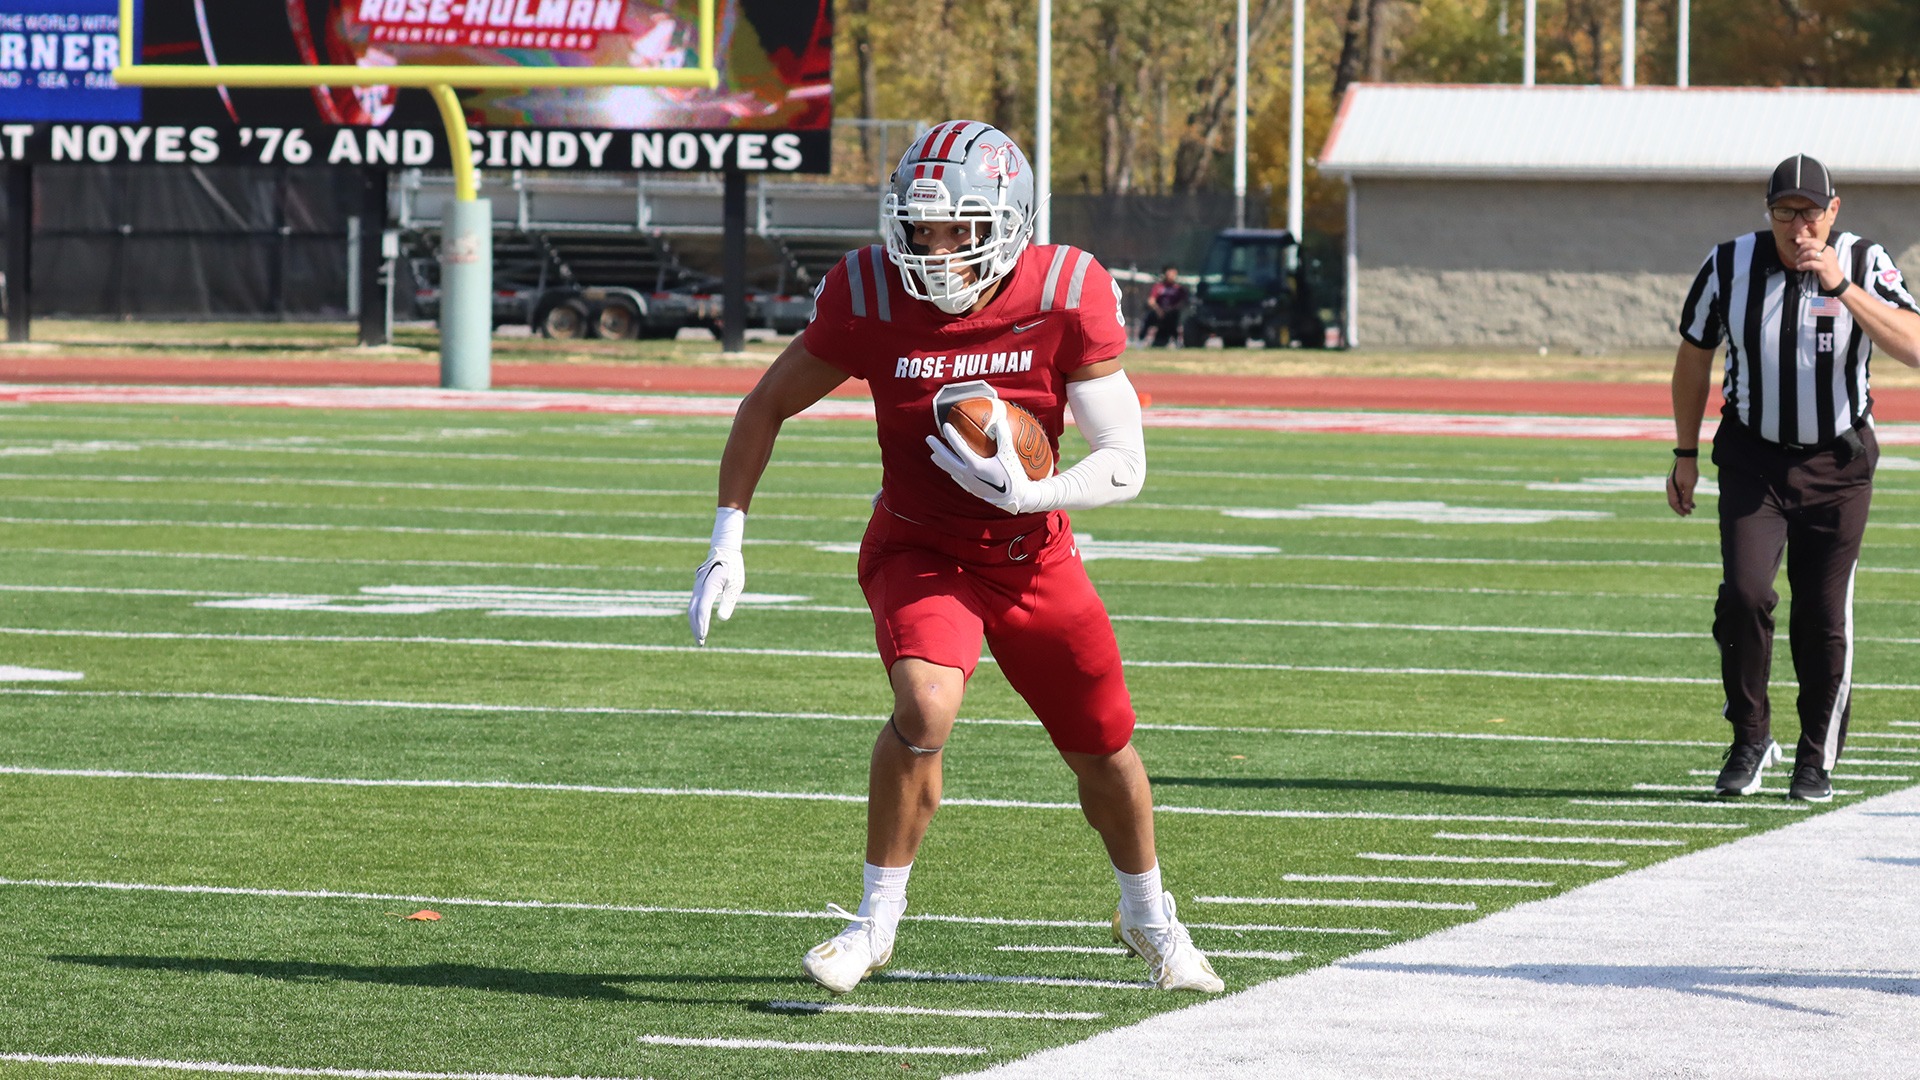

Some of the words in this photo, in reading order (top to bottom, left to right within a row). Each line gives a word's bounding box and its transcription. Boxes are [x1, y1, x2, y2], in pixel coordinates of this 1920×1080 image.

[25, 14, 79, 32] WORLD
[358, 0, 622, 30] ROSE-HULMAN
[0, 33, 119, 70] RNER
[37, 71, 68, 89] SEA
[0, 125, 34, 160] T
[51, 125, 220, 163] NOYES
[238, 127, 312, 164] '76
[327, 129, 434, 165] AND
[631, 132, 802, 170] NOYES
[1817, 332, 1833, 352] H
[895, 350, 1033, 378] ROSE-HULMAN
